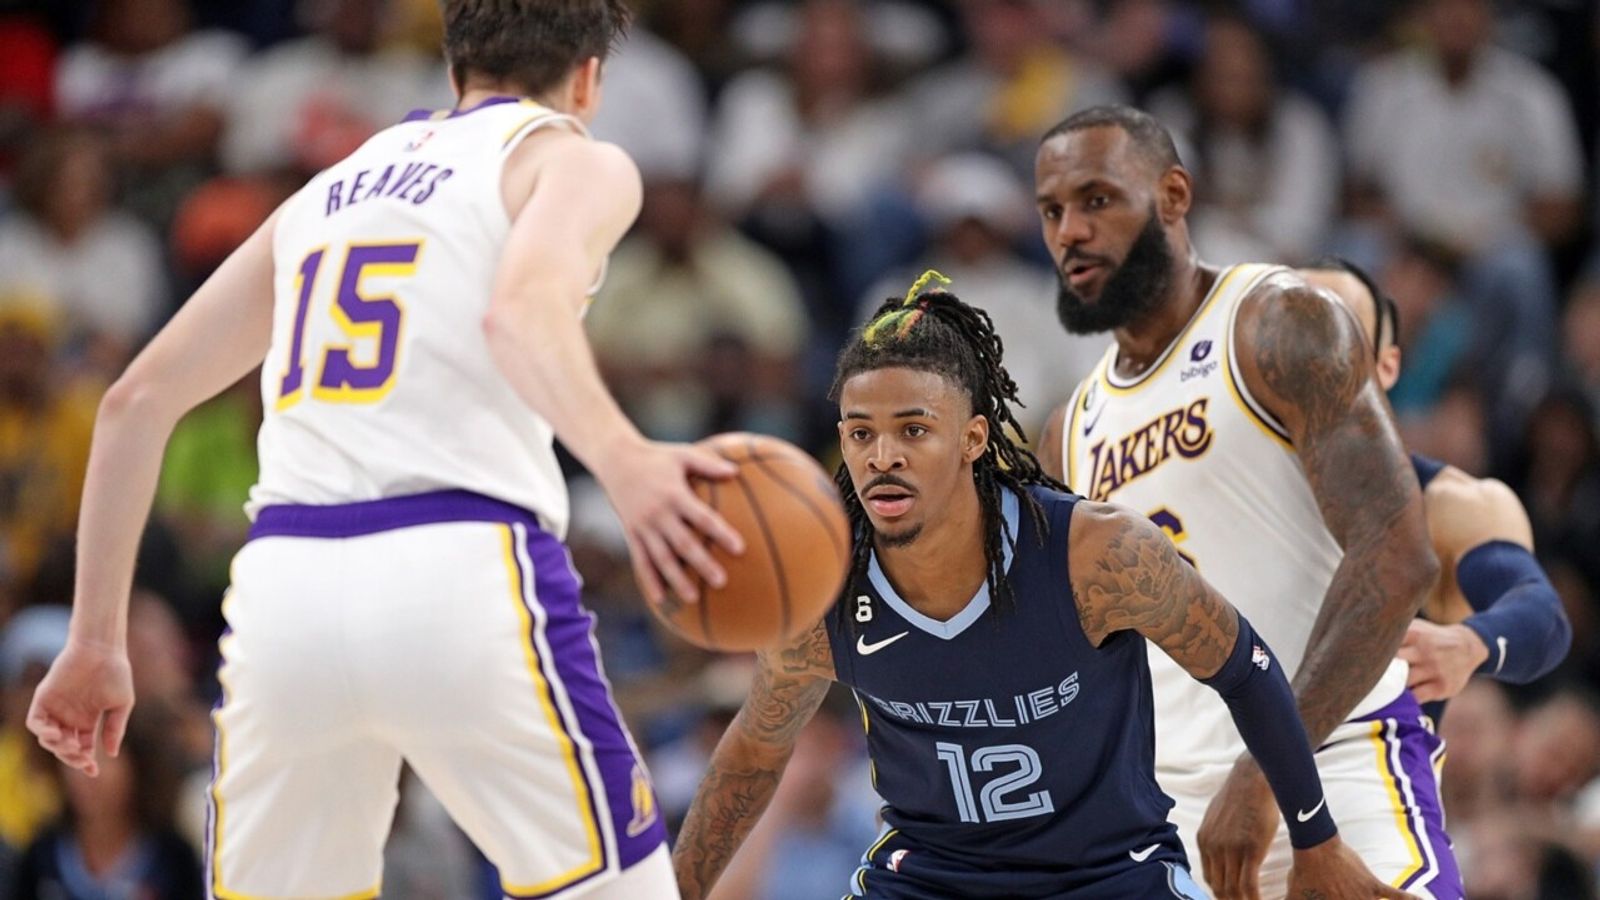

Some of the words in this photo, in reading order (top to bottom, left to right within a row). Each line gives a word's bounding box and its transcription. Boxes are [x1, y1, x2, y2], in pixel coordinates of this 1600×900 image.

[325, 163, 454, 217] REAVES
[274, 239, 426, 411] 15
[1087, 397, 1214, 503] LAKERS
[855, 595, 873, 622] 6
[935, 742, 1055, 824] 12
